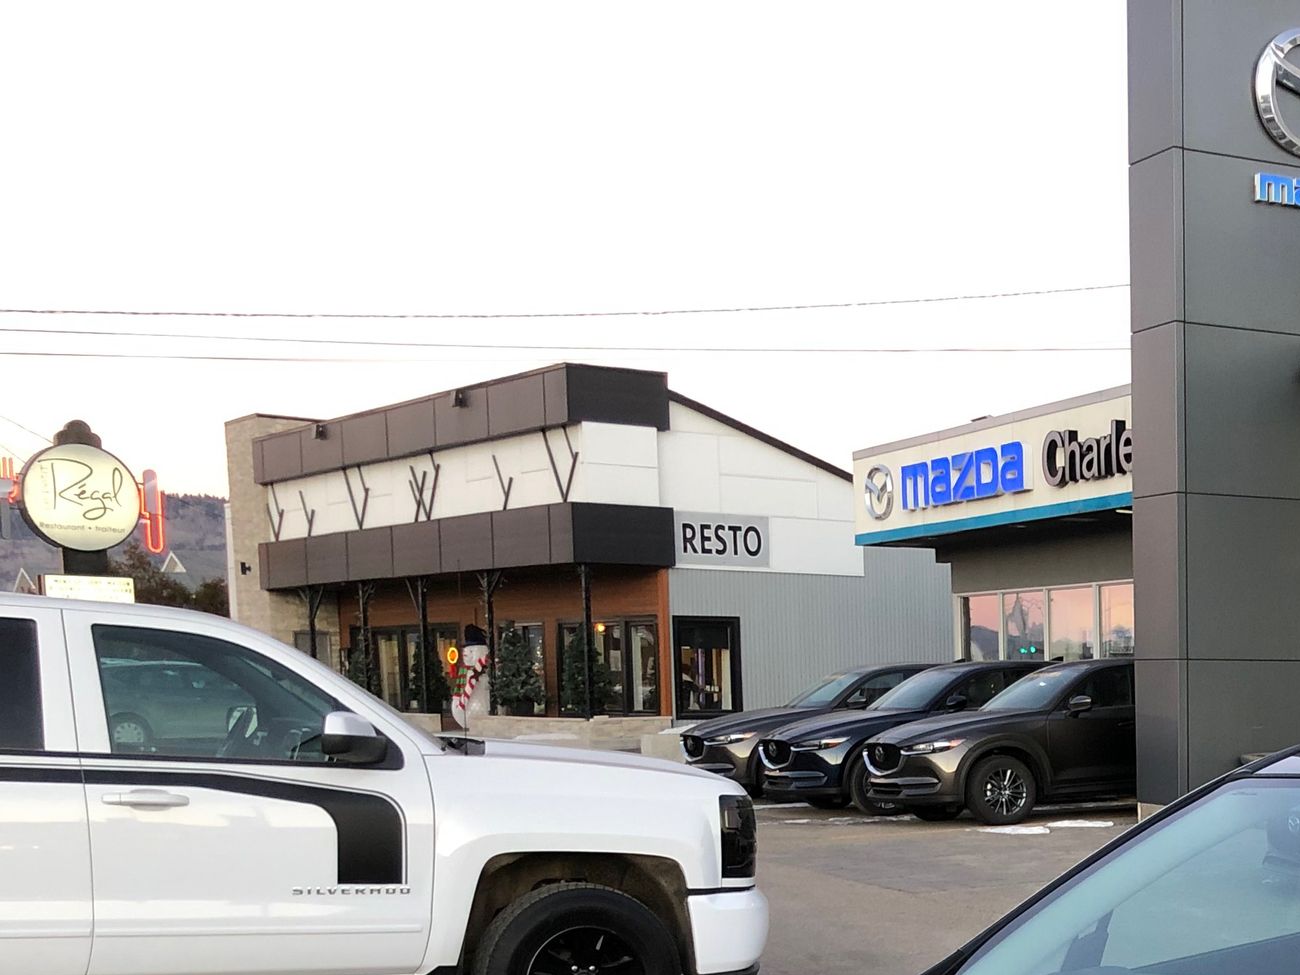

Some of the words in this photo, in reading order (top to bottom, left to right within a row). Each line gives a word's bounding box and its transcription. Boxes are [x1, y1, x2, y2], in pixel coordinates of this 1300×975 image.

[37, 457, 123, 521] Régal
[39, 521, 85, 531] Restaurant
[681, 522, 762, 557] RESTO
[292, 886, 411, 896] SILVERADO
